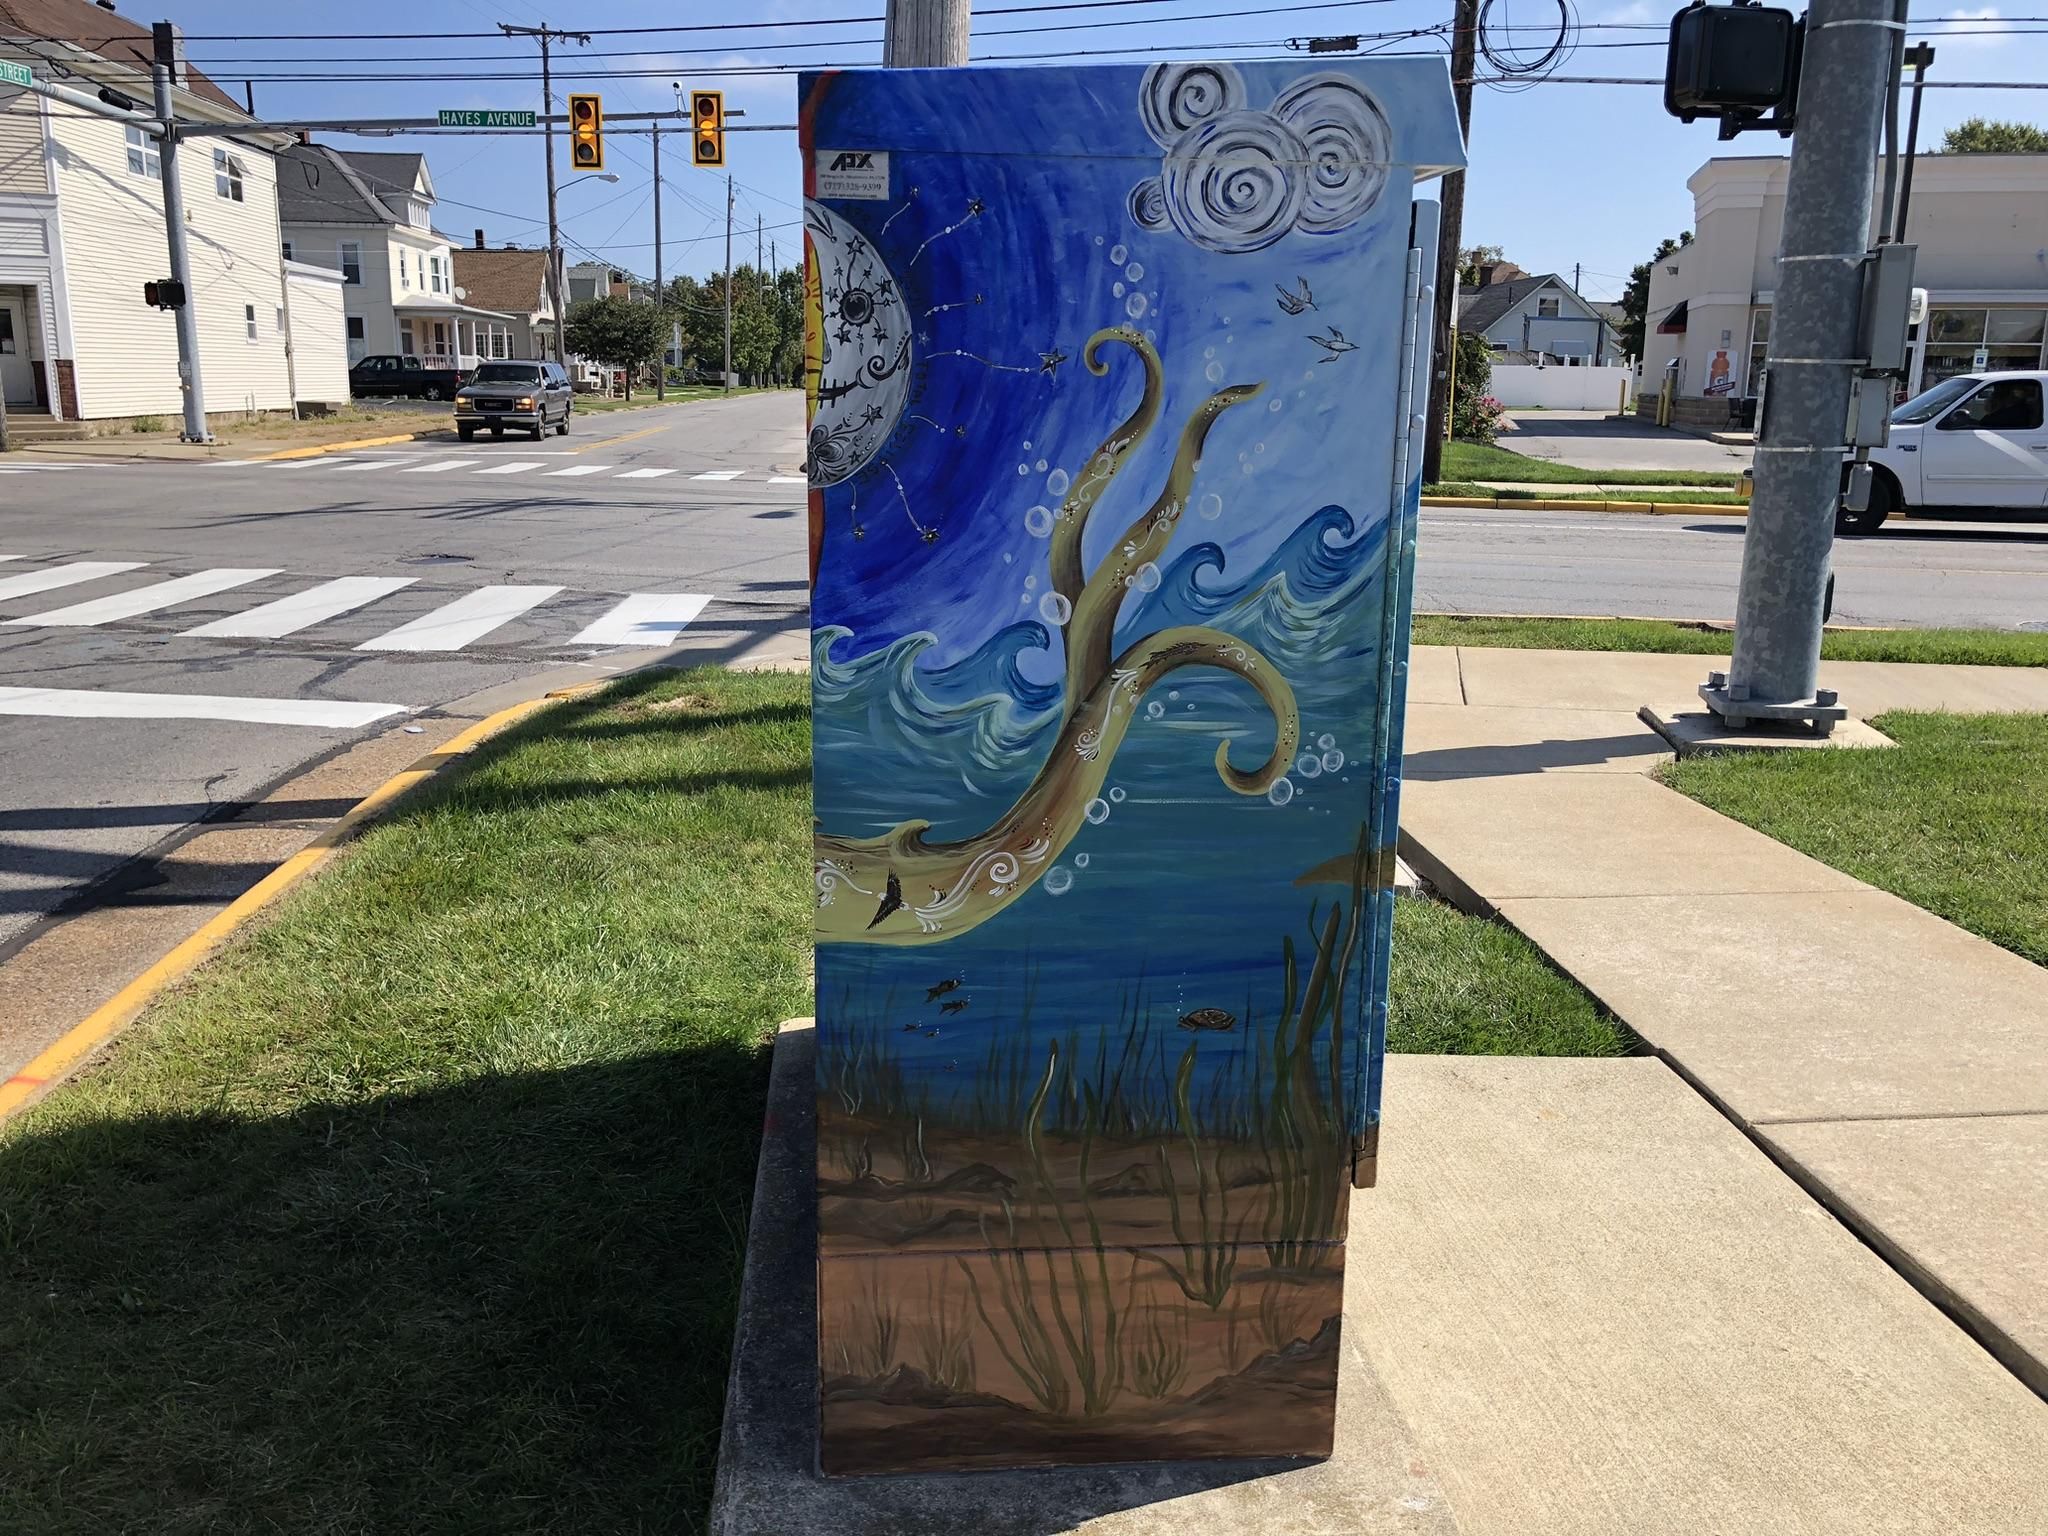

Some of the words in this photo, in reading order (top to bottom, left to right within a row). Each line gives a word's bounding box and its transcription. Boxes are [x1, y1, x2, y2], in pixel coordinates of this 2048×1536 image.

[0, 62, 28, 83] STREET
[441, 111, 481, 126] HAYES
[486, 112, 533, 126] AVENUE
